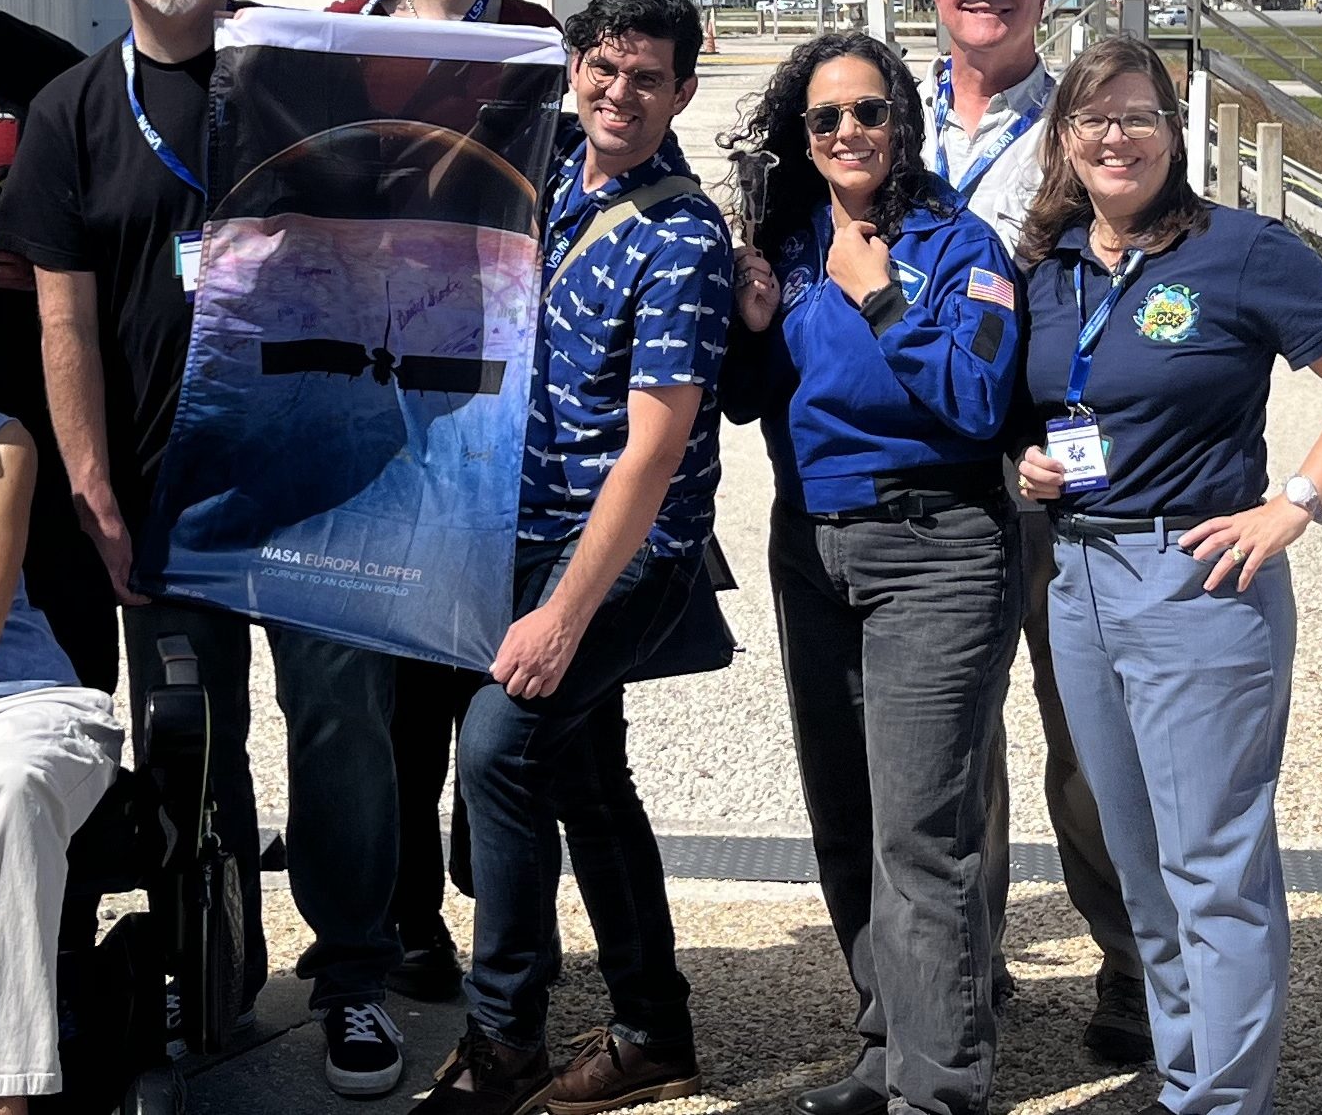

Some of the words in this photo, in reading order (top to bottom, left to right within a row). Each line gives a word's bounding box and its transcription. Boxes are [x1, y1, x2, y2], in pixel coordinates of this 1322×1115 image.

[137, 114, 162, 151] NASA
[984, 131, 1014, 159] NASA
[545, 237, 570, 269] NASA
[261, 546, 301, 564] NASA
[305, 553, 361, 573] EUROPA
[364, 562, 422, 582] CLIPPER
[260, 567, 305, 581] JOURNEY
[308, 575, 322, 584] TO
[323, 577, 337, 587] AN
[338, 579, 372, 592] OCEAN
[374, 584, 409, 597] WORLD
